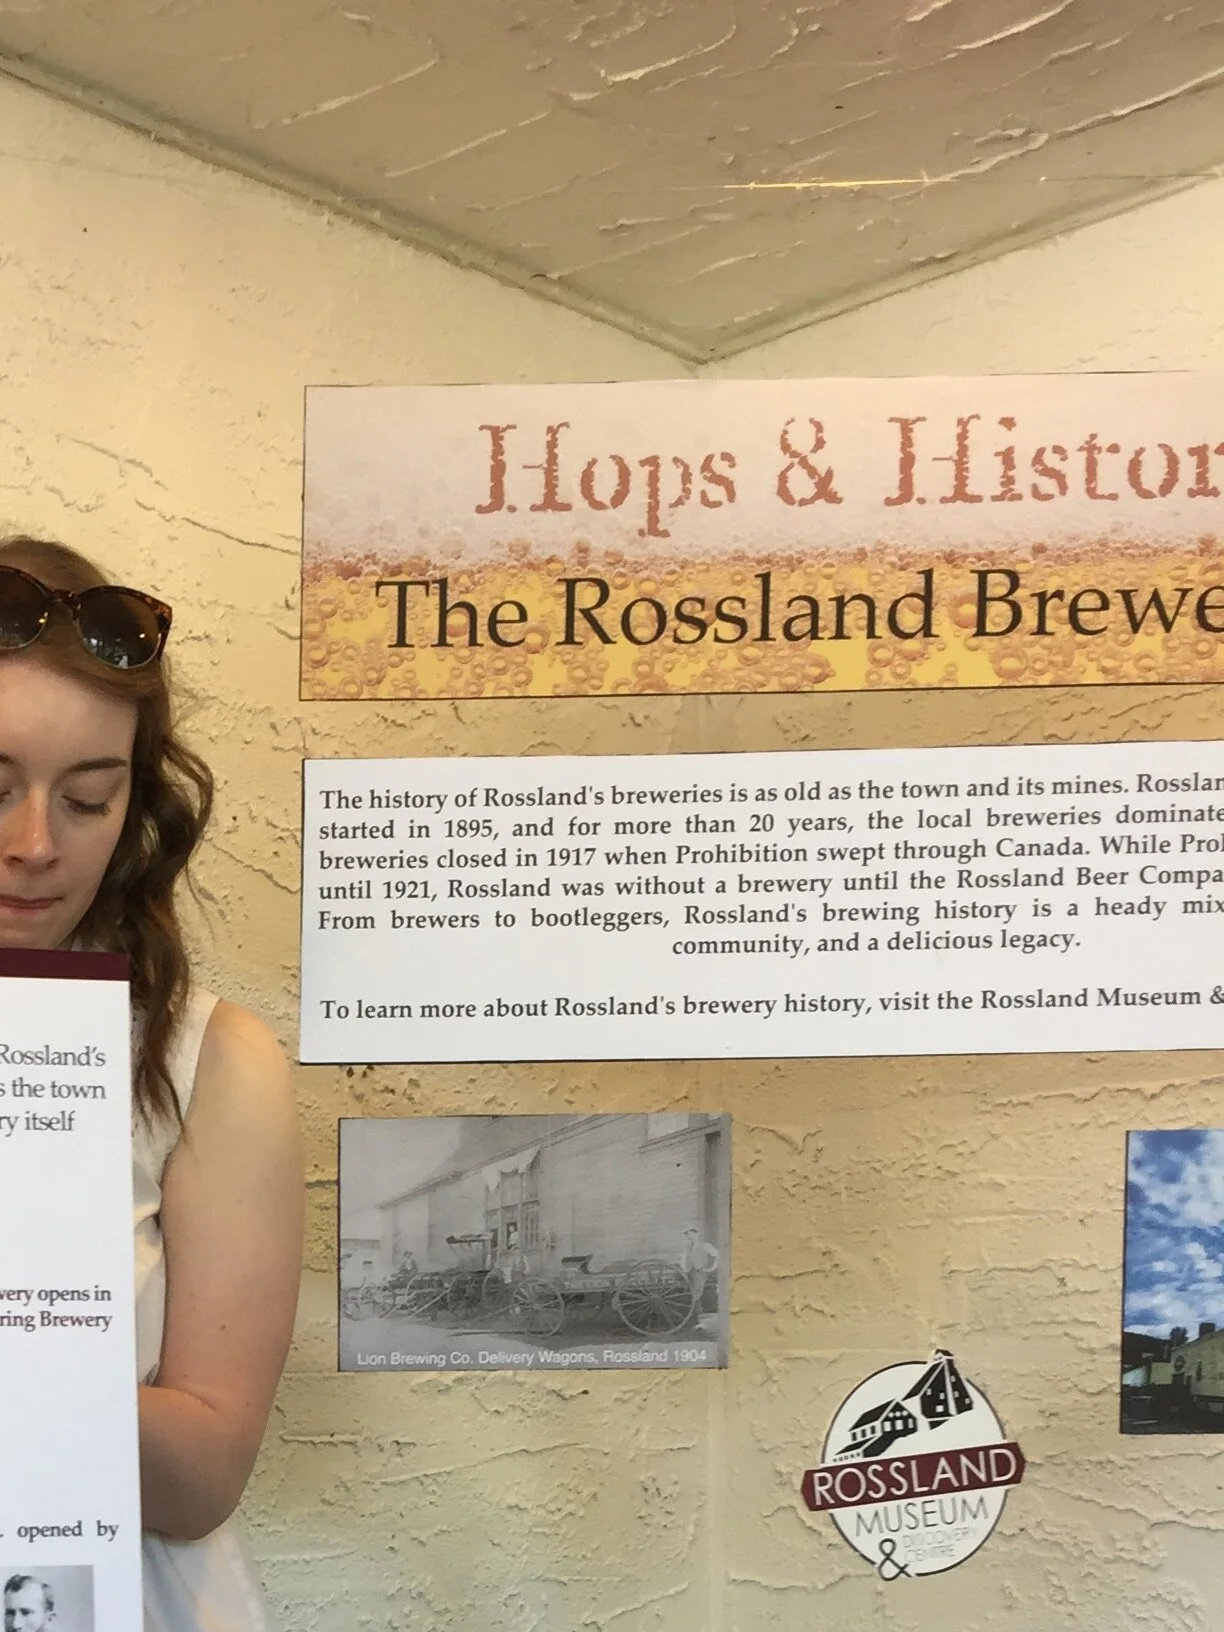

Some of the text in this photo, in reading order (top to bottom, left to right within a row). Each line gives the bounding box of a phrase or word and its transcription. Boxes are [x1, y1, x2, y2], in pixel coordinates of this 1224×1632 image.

[475, 422, 736, 538] Hops
[777, 416, 844, 506] &
[375, 577, 528, 648] The
[555, 567, 940, 646] Rossland
[319, 790, 362, 809] The
[369, 789, 448, 814] history
[454, 788, 478, 807] of
[483, 786, 604, 807] Rossland's
[611, 784, 722, 804] breweries
[730, 783, 748, 802] is
[755, 788, 778, 801] as
[784, 781, 821, 801] old
[828, 786, 851, 800] as
[858, 780, 894, 799] the
[901, 781, 959, 798] town
[967, 777, 1010, 796] and
[1017, 777, 1044, 795] its
[1052, 775, 1128, 794] mines.
[320, 1000, 349, 1019] To
[356, 1000, 412, 1018] learn
[420, 1004, 476, 1017] more
[484, 998, 548, 1017] about
[555, 996, 675, 1016] Rossland's
[683, 995, 777, 1019] brewery
[784, 993, 872, 1017] history,
[879, 992, 930, 1010] visit
[937, 991, 973, 1009] the
[981, 988, 1088, 1008] Rossland
[1097, 988, 1201, 1006] Museum
[11, 1077, 45, 1098] the
[50, 1080, 106, 1099] town
[25, 1110, 75, 1131] itself
[37, 1290, 90, 1306] opens
[94, 1285, 111, 1301] in
[357, 1352, 386, 1365] Lion
[390, 1351, 446, 1368] Brewing
[450, 1351, 474, 1365] Co.
[478, 1351, 535, 1367] Delivery
[538, 1350, 599, 1366] Wagons,
[603, 1350, 668, 1363] Rossland
[812, 1448, 1018, 1506] ROSSLAND
[17, 1520, 82, 1543] opened
[96, 1520, 119, 1541] by
[855, 1495, 989, 1537] MUSEUM
[877, 1538, 912, 1582] &
